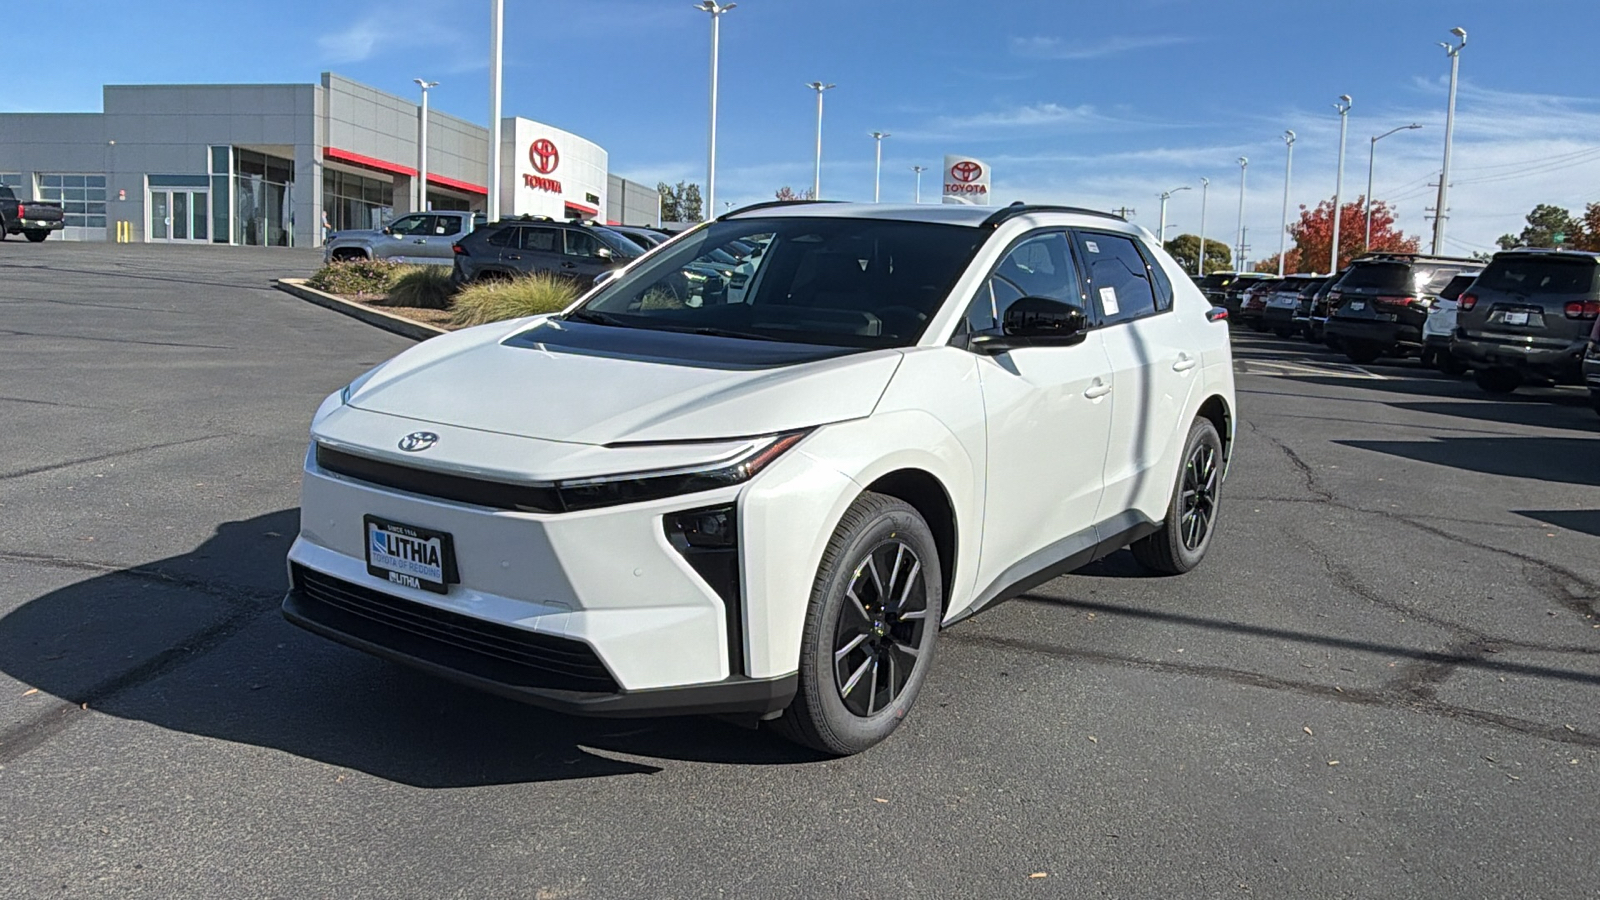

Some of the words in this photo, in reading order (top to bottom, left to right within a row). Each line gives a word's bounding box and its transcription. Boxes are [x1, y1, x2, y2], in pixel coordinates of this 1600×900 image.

[523, 173, 562, 194] TOYOTA
[945, 184, 987, 193] TOYOTA
[387, 534, 440, 567] LITHIA
[373, 552, 398, 566] TOYOTA
[399, 560, 408, 569] OF
[409, 562, 441, 578] REDDING
[396, 573, 421, 589] LITHIA
